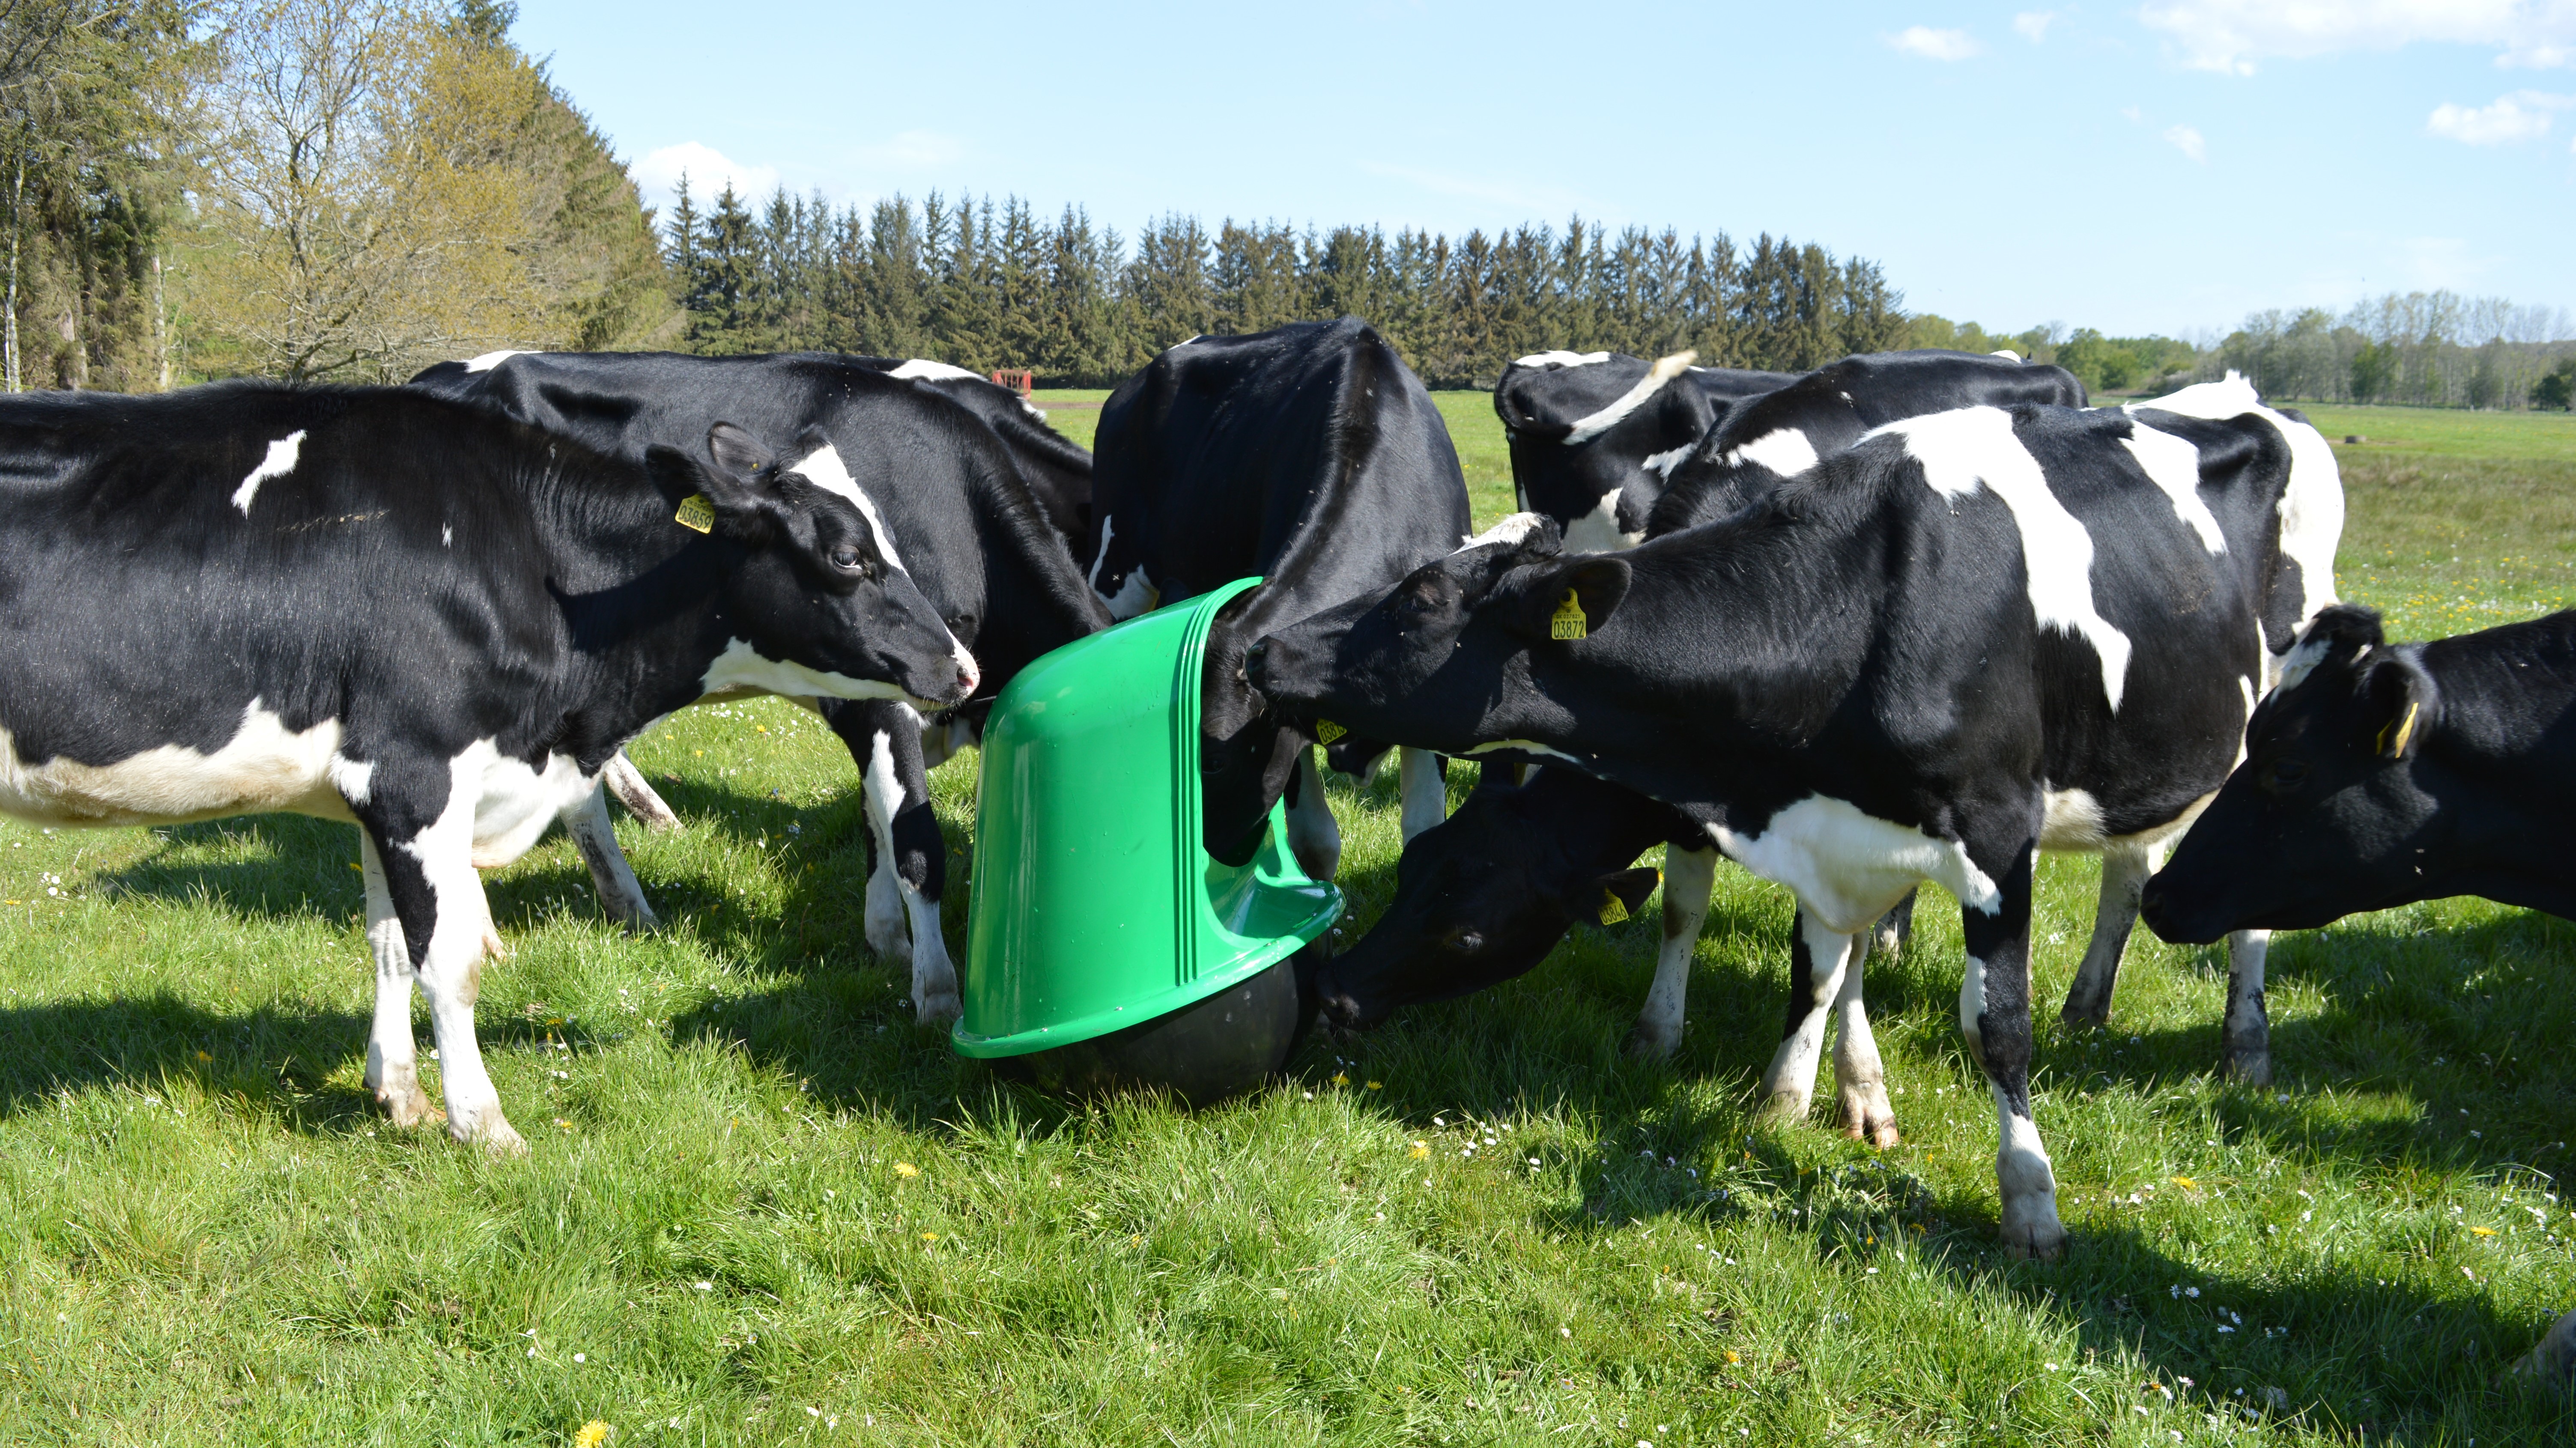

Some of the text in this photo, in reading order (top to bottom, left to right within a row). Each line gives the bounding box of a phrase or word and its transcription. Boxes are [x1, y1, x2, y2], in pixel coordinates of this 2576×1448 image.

[679, 505, 712, 529] 03859
[1554, 620, 1584, 638] 03872
[1600, 903, 1627, 924] 03846
